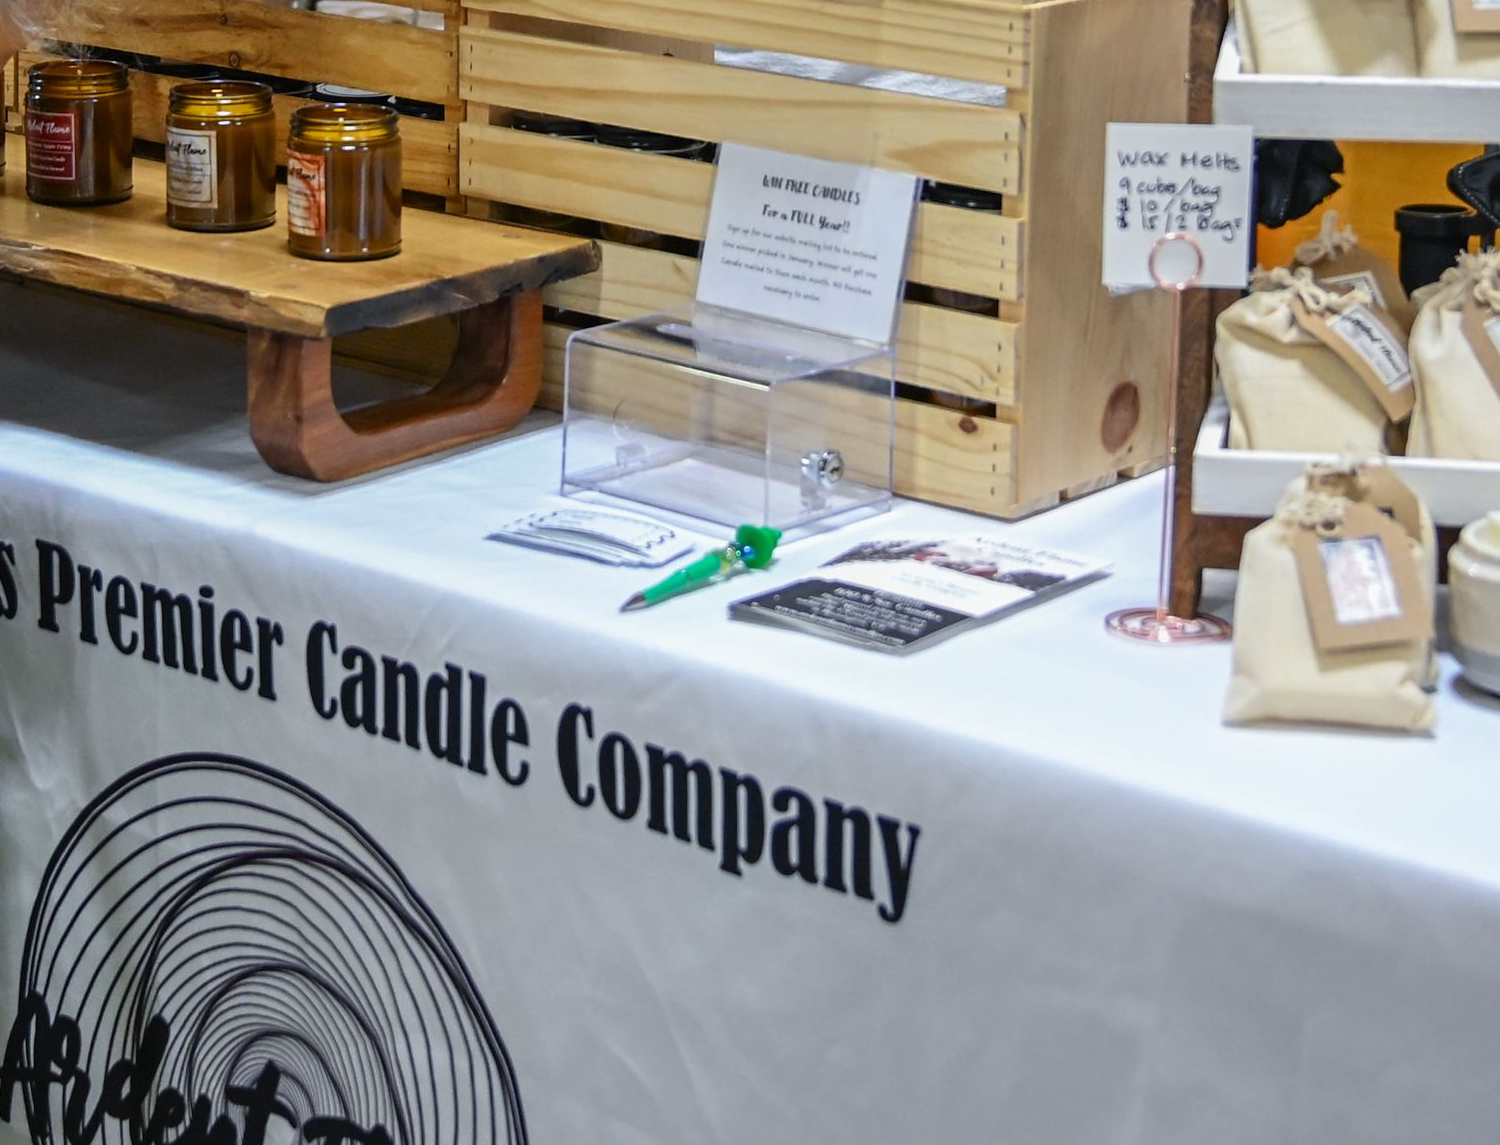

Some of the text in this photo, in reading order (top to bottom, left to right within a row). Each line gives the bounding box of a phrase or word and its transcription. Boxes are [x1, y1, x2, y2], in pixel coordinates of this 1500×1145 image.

[1117, 150, 1169, 167] Wax
[762, 175, 860, 205] WIN FREE CANDLES
[762, 204, 778, 217] For
[791, 210, 814, 225] FULL
[819, 215, 850, 233] Year!!
[35, 538, 283, 702] Premier
[306, 620, 530, 787] Candle
[557, 703, 921, 924] Company
